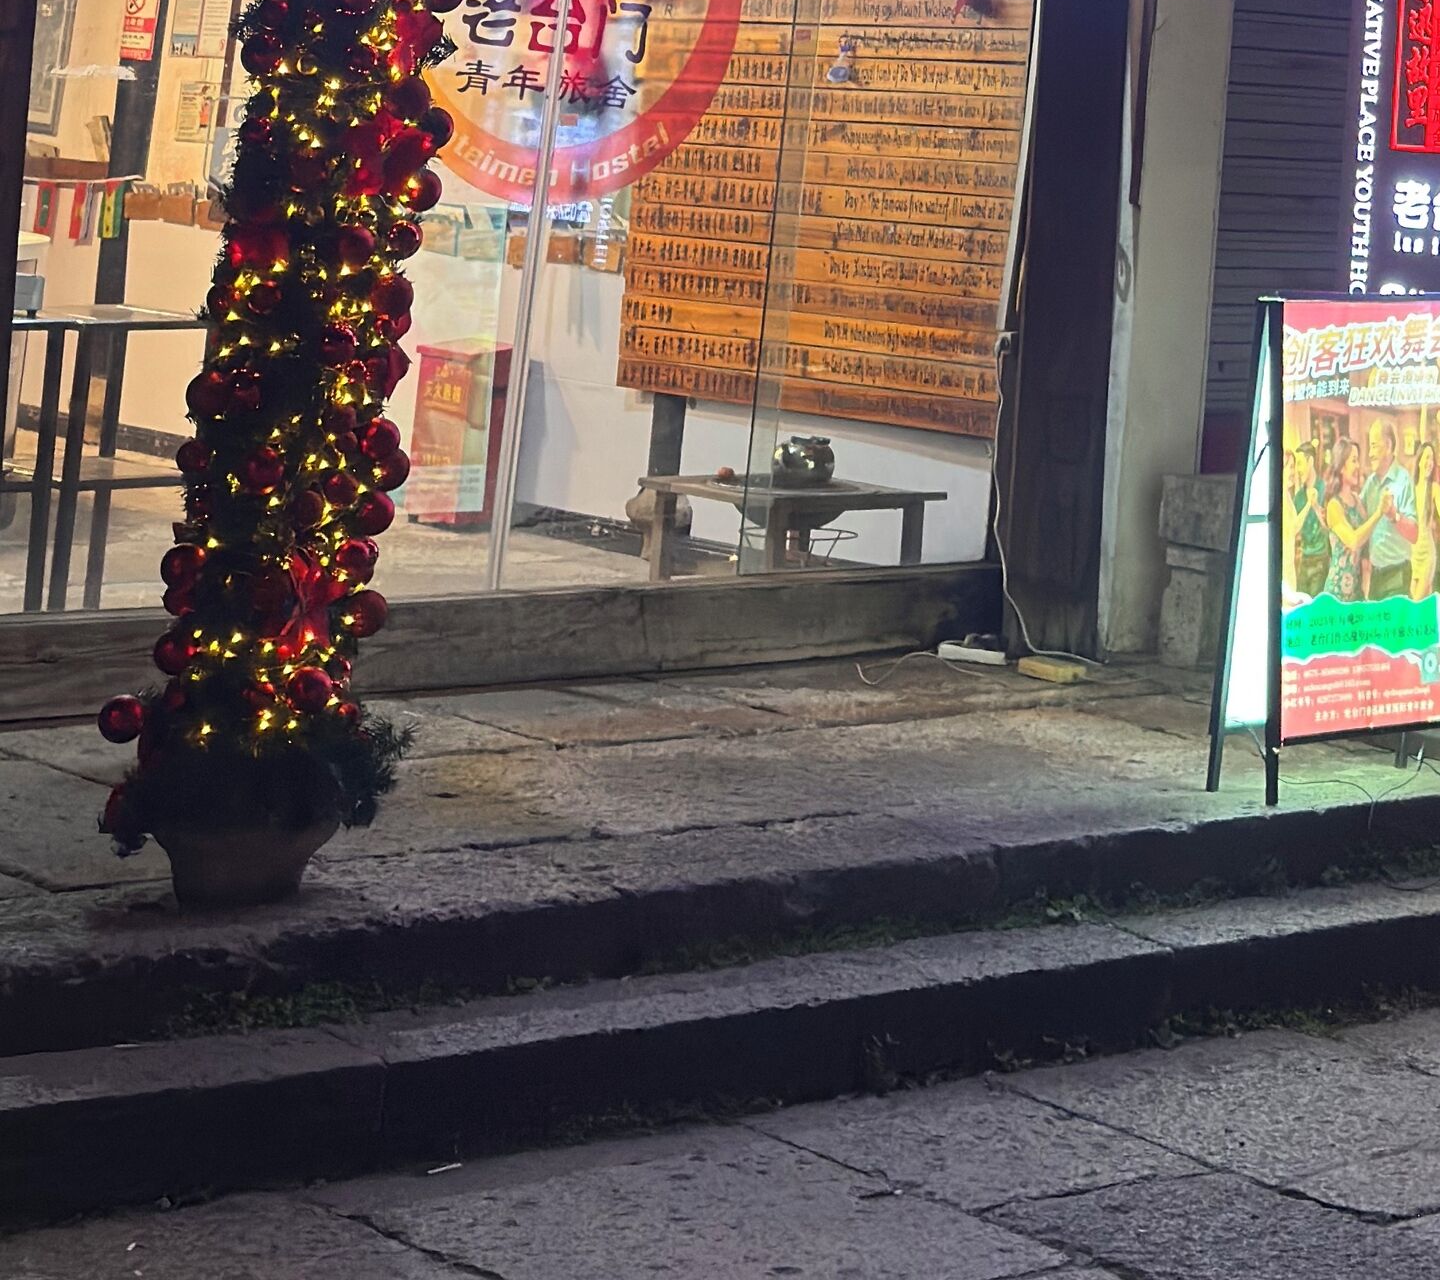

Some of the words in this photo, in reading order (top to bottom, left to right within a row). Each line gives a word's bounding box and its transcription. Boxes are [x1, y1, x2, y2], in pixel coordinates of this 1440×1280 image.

[456, 59, 638, 110] 青年旅舍
[1356, 78, 1379, 162] PLACE
[570, 121, 671, 186] Hostel
[1351, 165, 1373, 267] YOUTH
